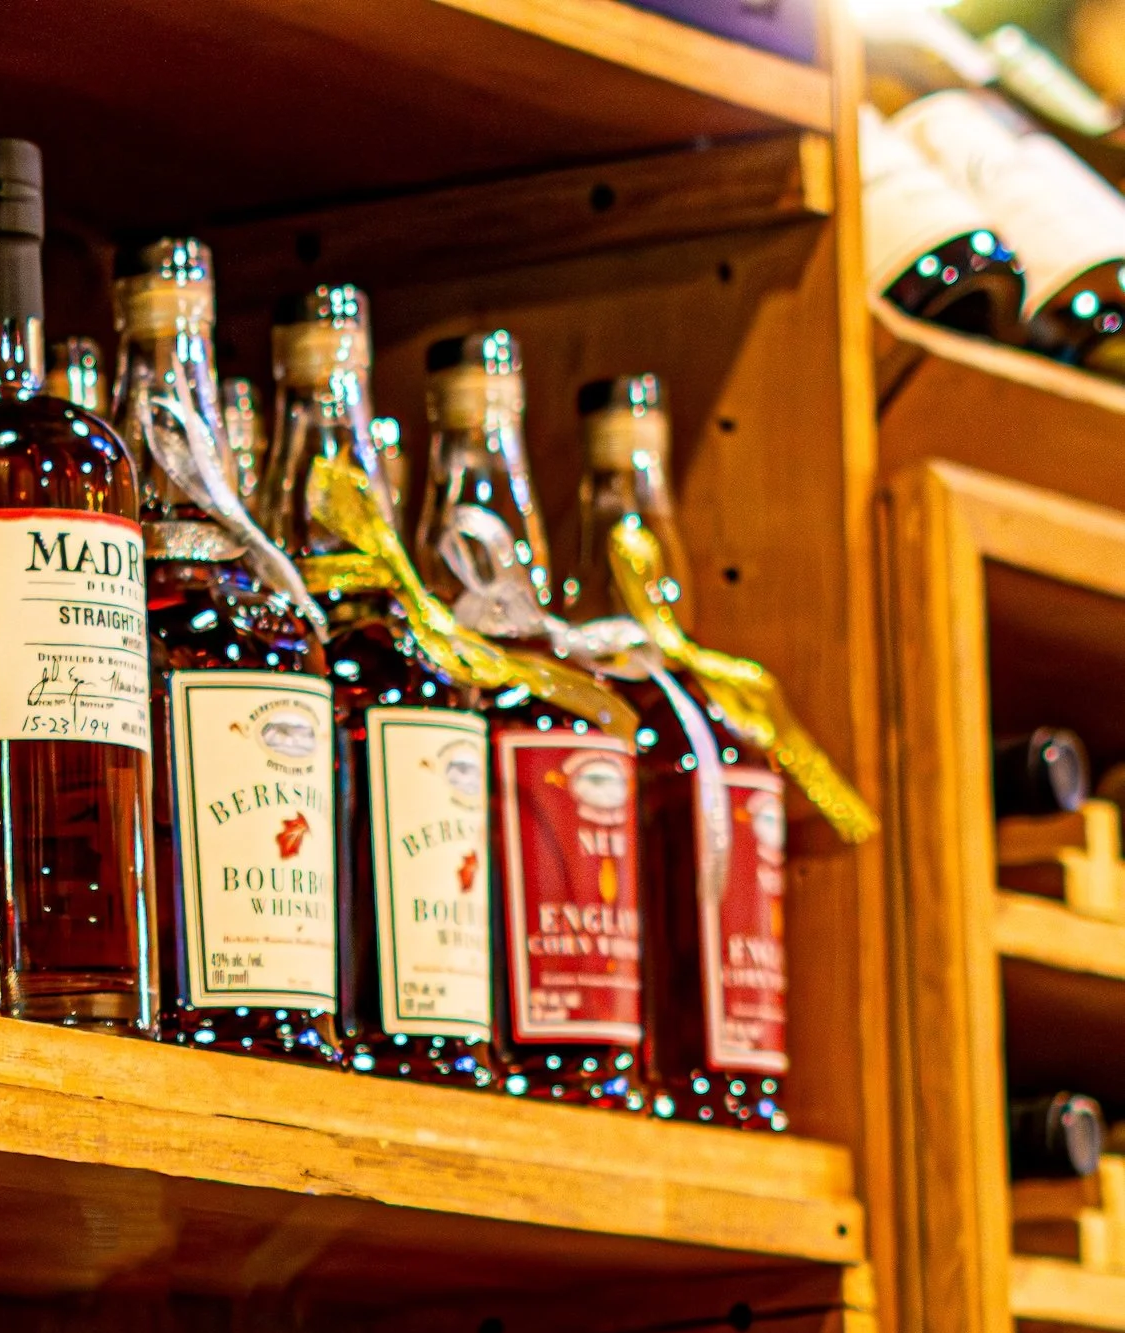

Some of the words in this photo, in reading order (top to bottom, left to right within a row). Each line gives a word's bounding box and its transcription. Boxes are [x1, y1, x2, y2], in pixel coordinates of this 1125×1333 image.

[59, 606, 134, 633] STRAIGHT
[22, 714, 70, 735] 15-23
[80, 716, 109, 738] 194
